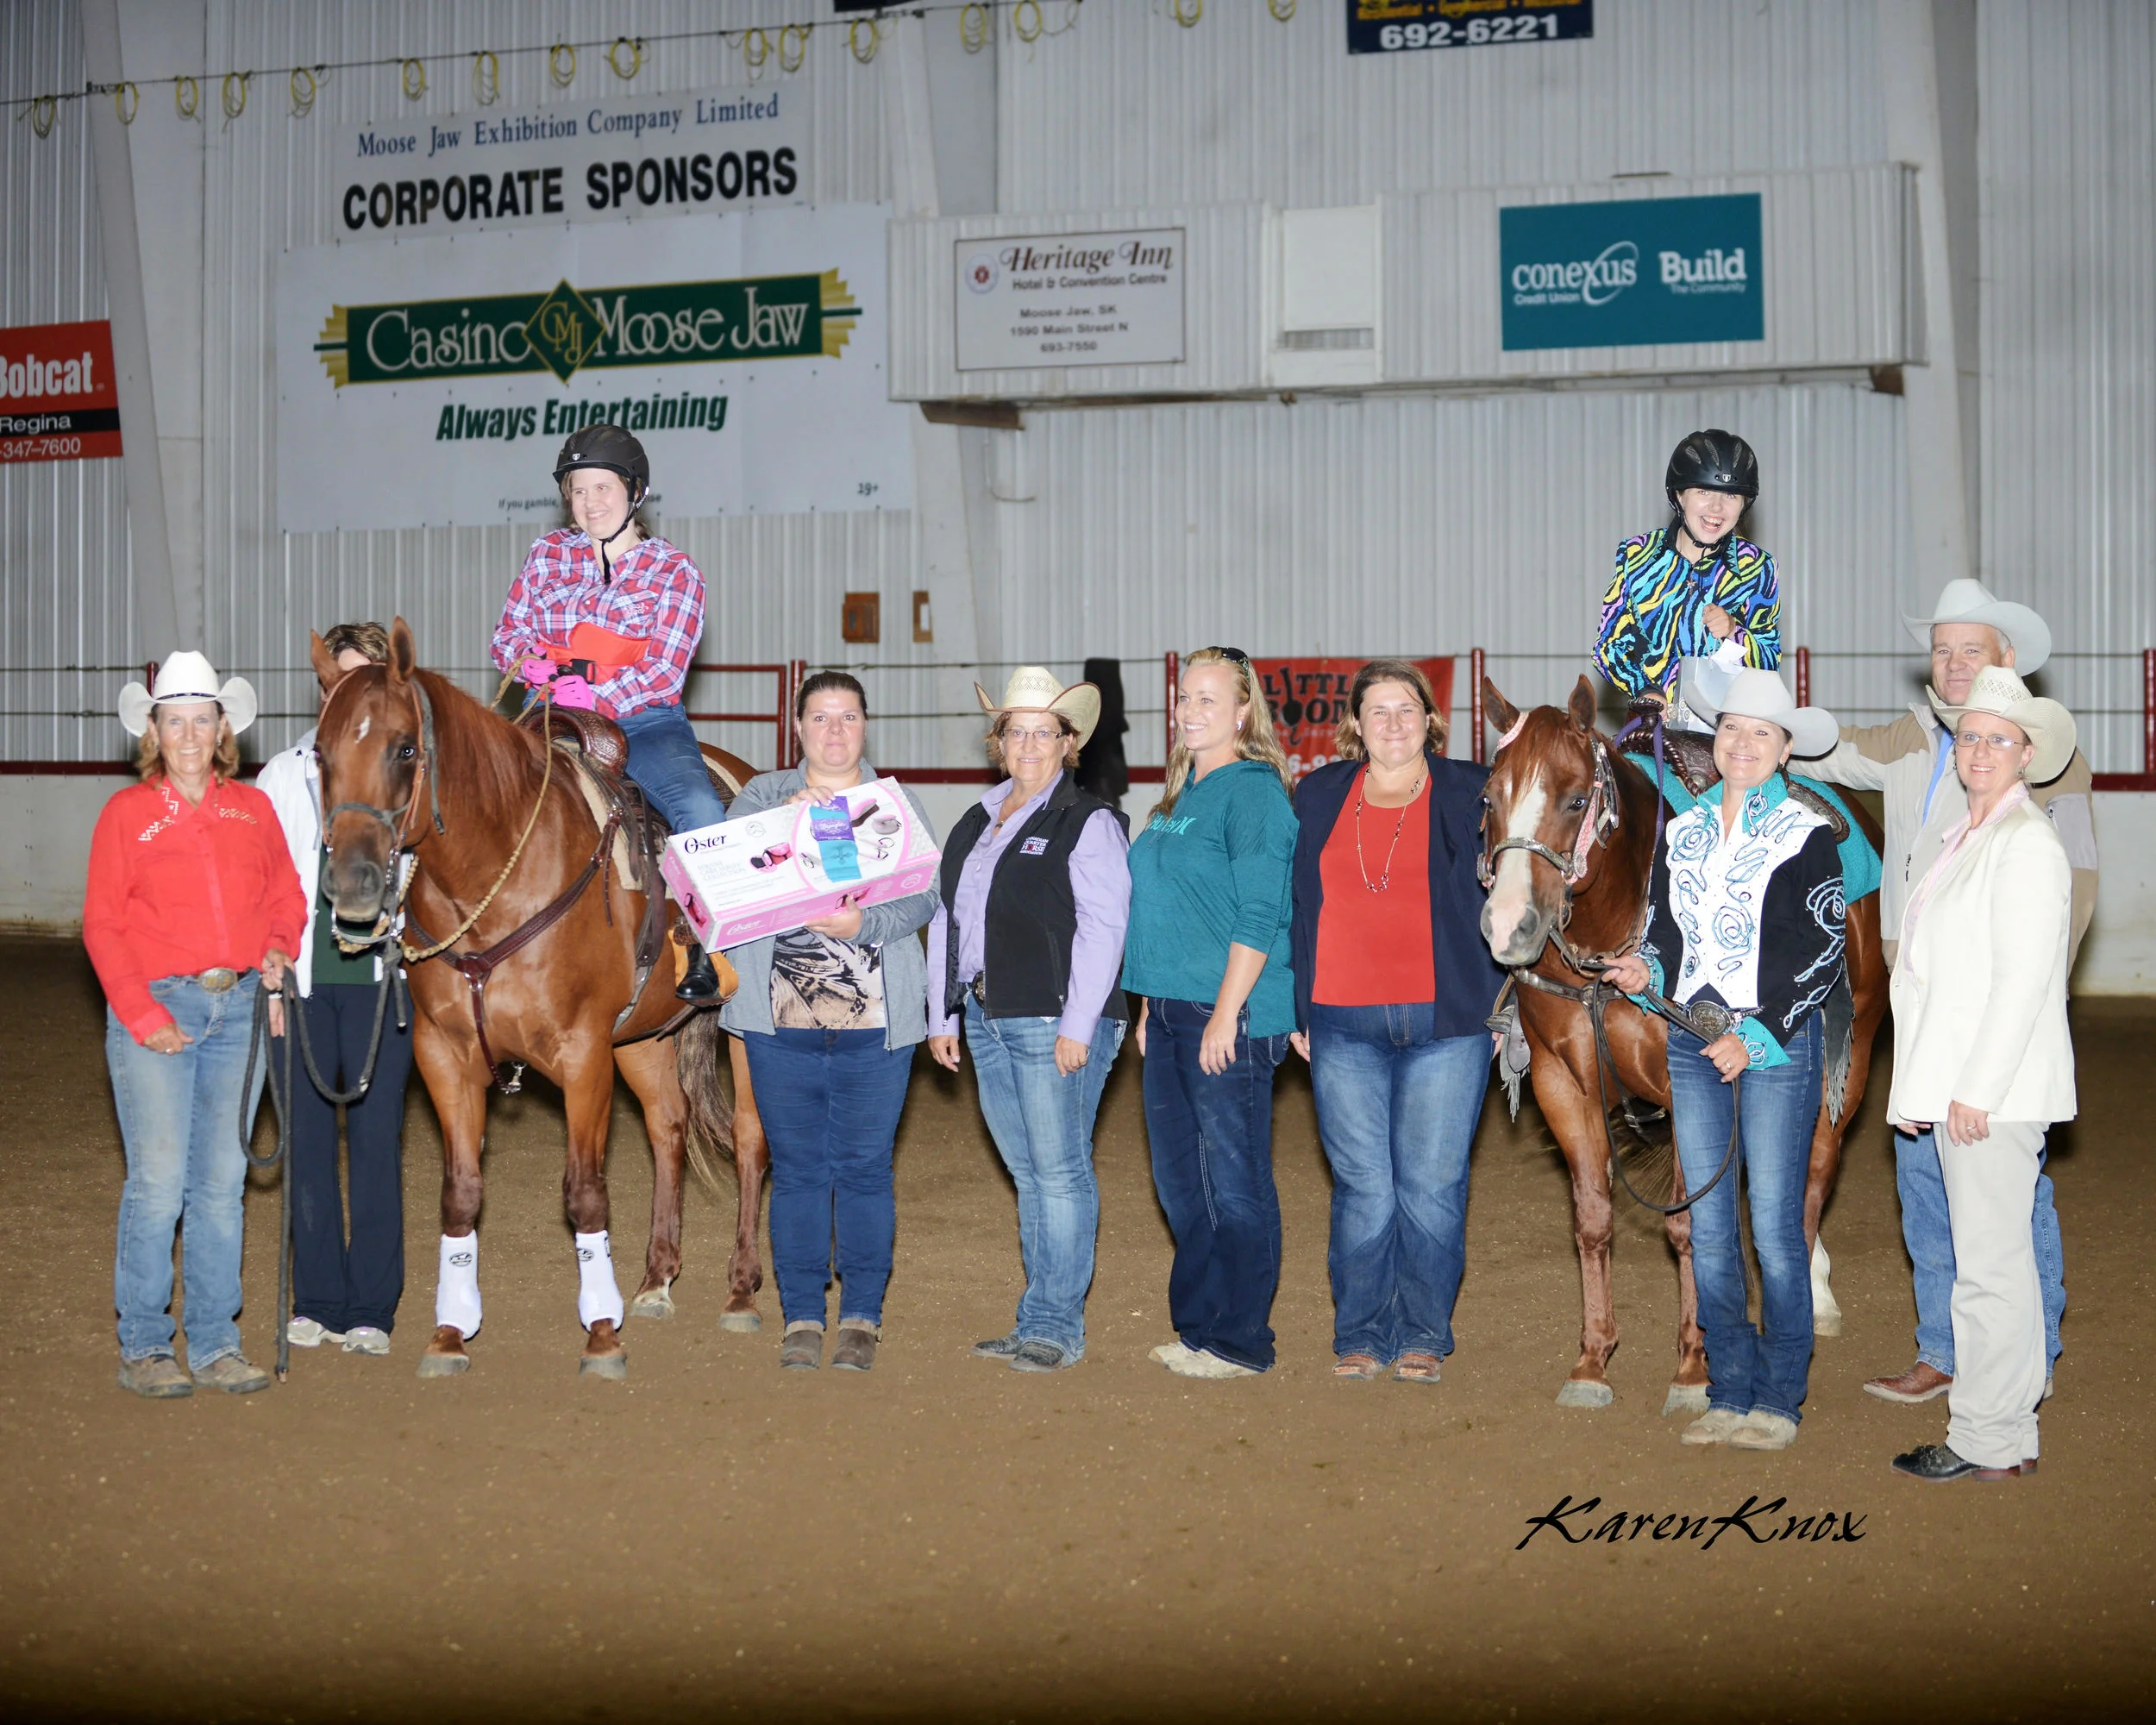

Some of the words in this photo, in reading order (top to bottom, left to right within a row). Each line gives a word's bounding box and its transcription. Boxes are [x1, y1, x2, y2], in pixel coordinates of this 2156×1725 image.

[1380, 14, 1557, 49] 692-6221
[357, 130, 417, 156] Moose
[429, 126, 461, 156] Jaw
[474, 116, 577, 146] Exhibition
[587, 107, 682, 141] Company
[696, 93, 779, 124] Limited
[344, 167, 564, 230] CORPORATE
[586, 147, 797, 210] SPONSORS
[1000, 244, 1114, 274] Heritage
[1119, 241, 1174, 270] Inn
[1512, 247, 1639, 302] conexus
[1659, 248, 1747, 285] Build
[1012, 276, 1043, 291] Hotel
[1059, 273, 1125, 289] Convention
[1129, 272, 1167, 285] Centre
[592, 295, 724, 360] Moose
[730, 286, 809, 351] Jaw
[1020, 307, 1062, 319] Moose
[1099, 304, 1117, 315] SK
[1043, 323, 1073, 336] Main
[1077, 323, 1114, 335] Street
[1119, 321, 1128, 332] N
[367, 307, 531, 373] Casino
[0, 414, 72, 436] Regina
[436, 401, 536, 442] Always
[542, 392, 728, 435] Entertaining
[507, 499, 523, 511] you
[684, 835, 727, 855] Oster
